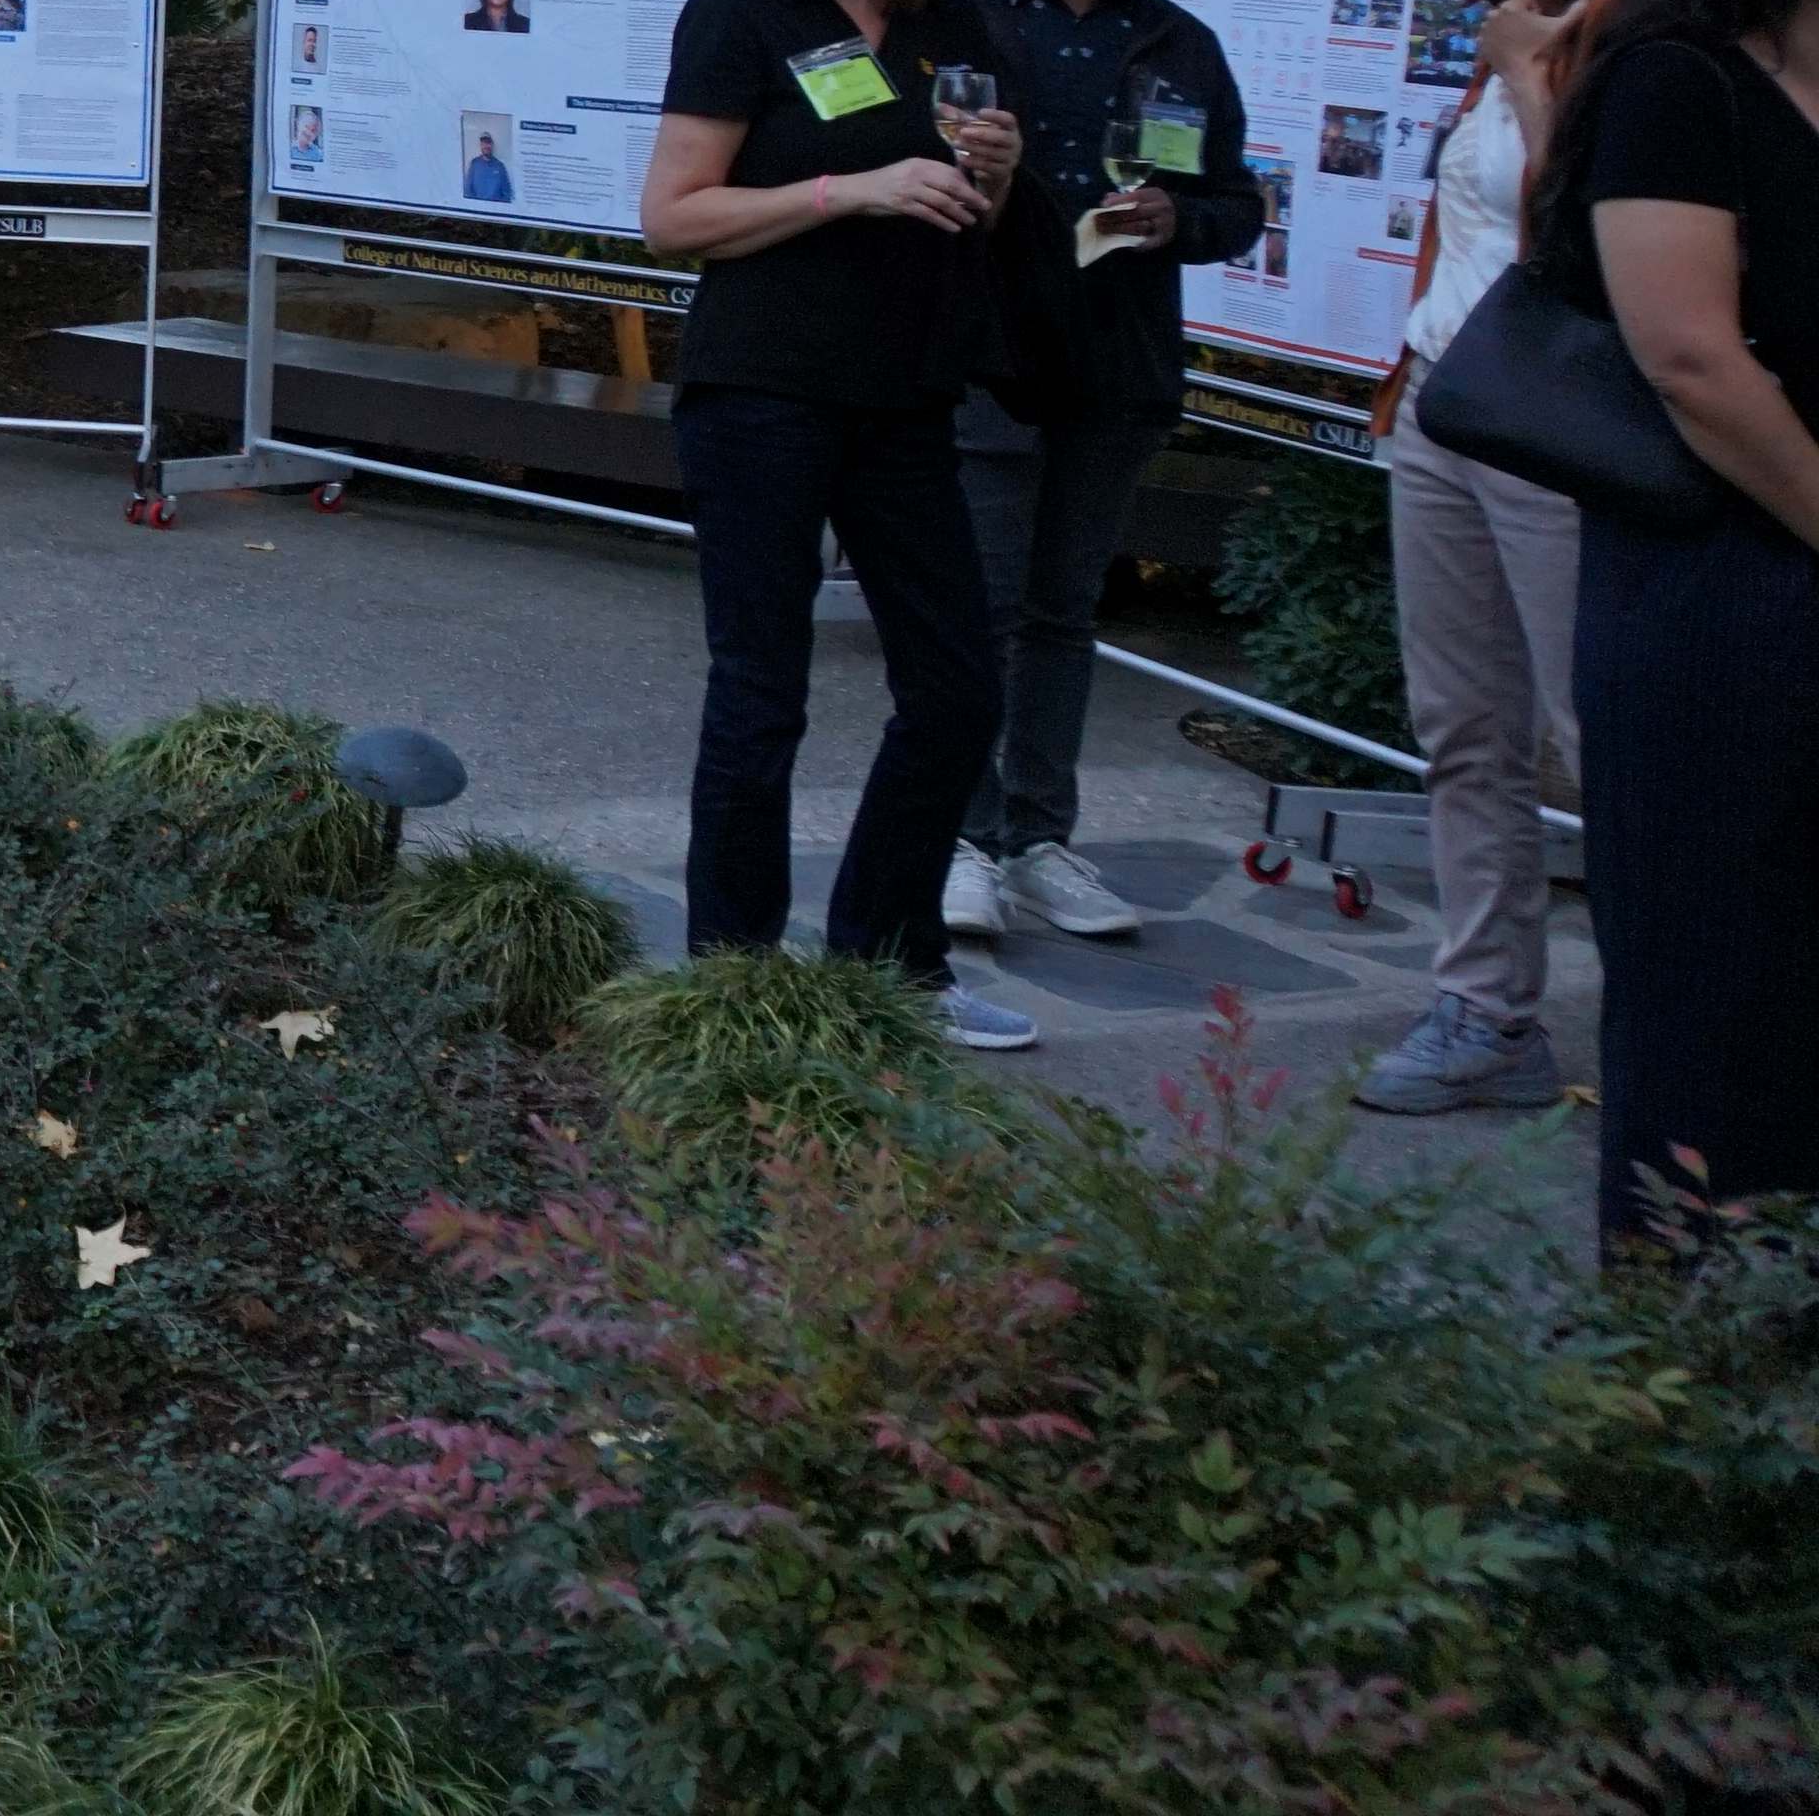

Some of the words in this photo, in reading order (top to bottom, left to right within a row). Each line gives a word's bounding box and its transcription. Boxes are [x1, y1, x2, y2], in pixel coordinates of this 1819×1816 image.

[345, 244, 394, 266] College
[395, 252, 410, 267] of
[411, 252, 468, 275] Natural
[470, 259, 529, 283] Sciences
[531, 270, 559, 288] and
[1315, 420, 1373, 454] CSULB
